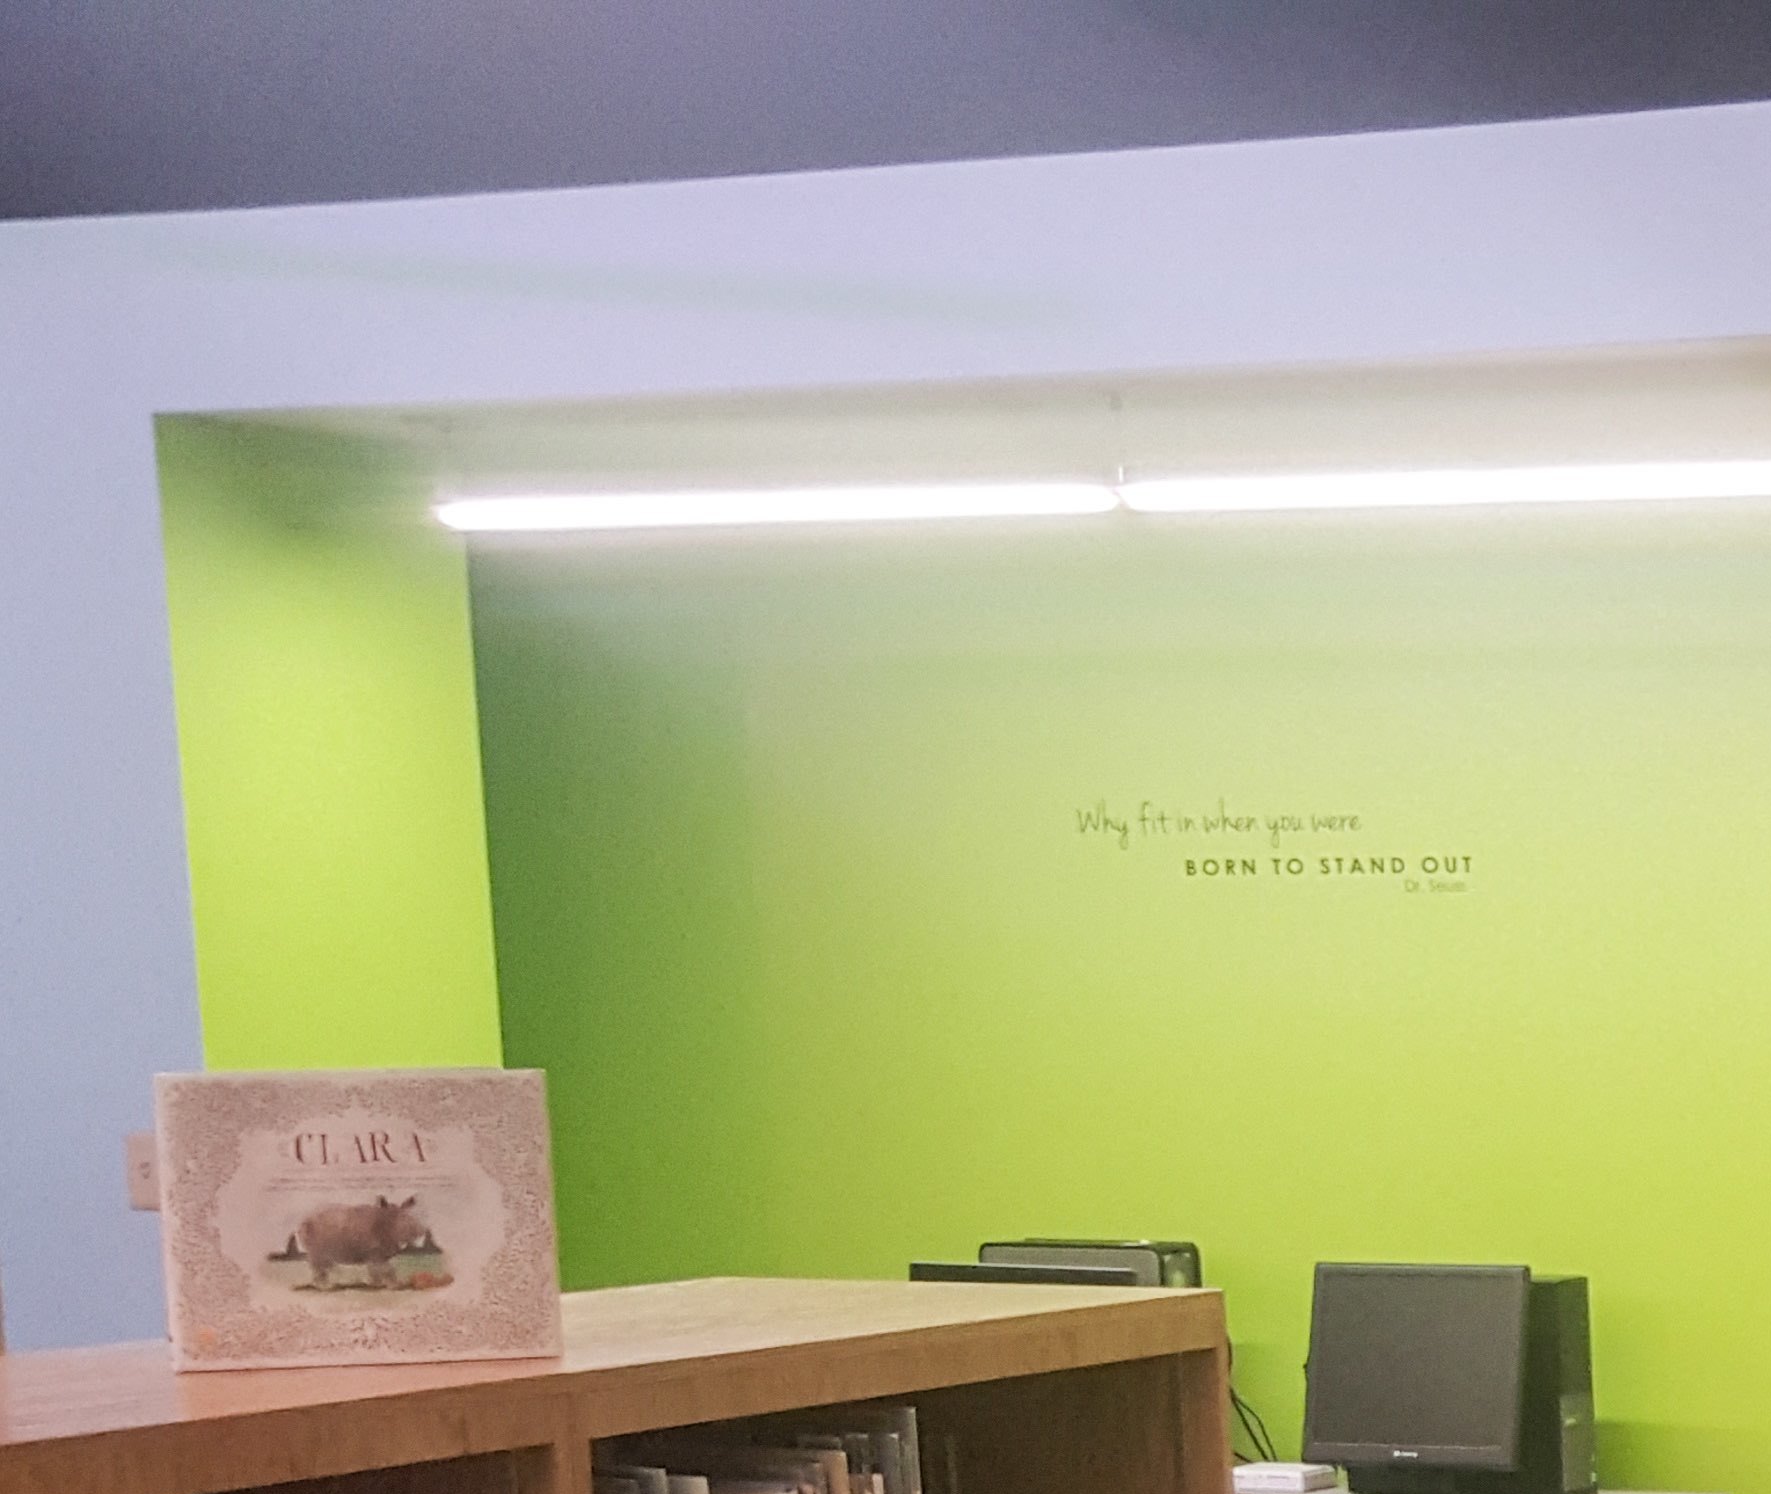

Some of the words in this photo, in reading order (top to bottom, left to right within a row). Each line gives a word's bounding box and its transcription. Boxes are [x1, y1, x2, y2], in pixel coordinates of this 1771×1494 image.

[1077, 798, 1129, 850] Why
[1138, 801, 1167, 835] fit
[1178, 811, 1195, 832] in
[1203, 797, 1256, 832] when
[1266, 815, 1304, 848] you
[1310, 813, 1361, 832] were
[1185, 858, 1257, 876] BORN
[1273, 858, 1305, 875] TO
[1319, 856, 1406, 875] STAND
[1421, 855, 1473, 874] OUT
